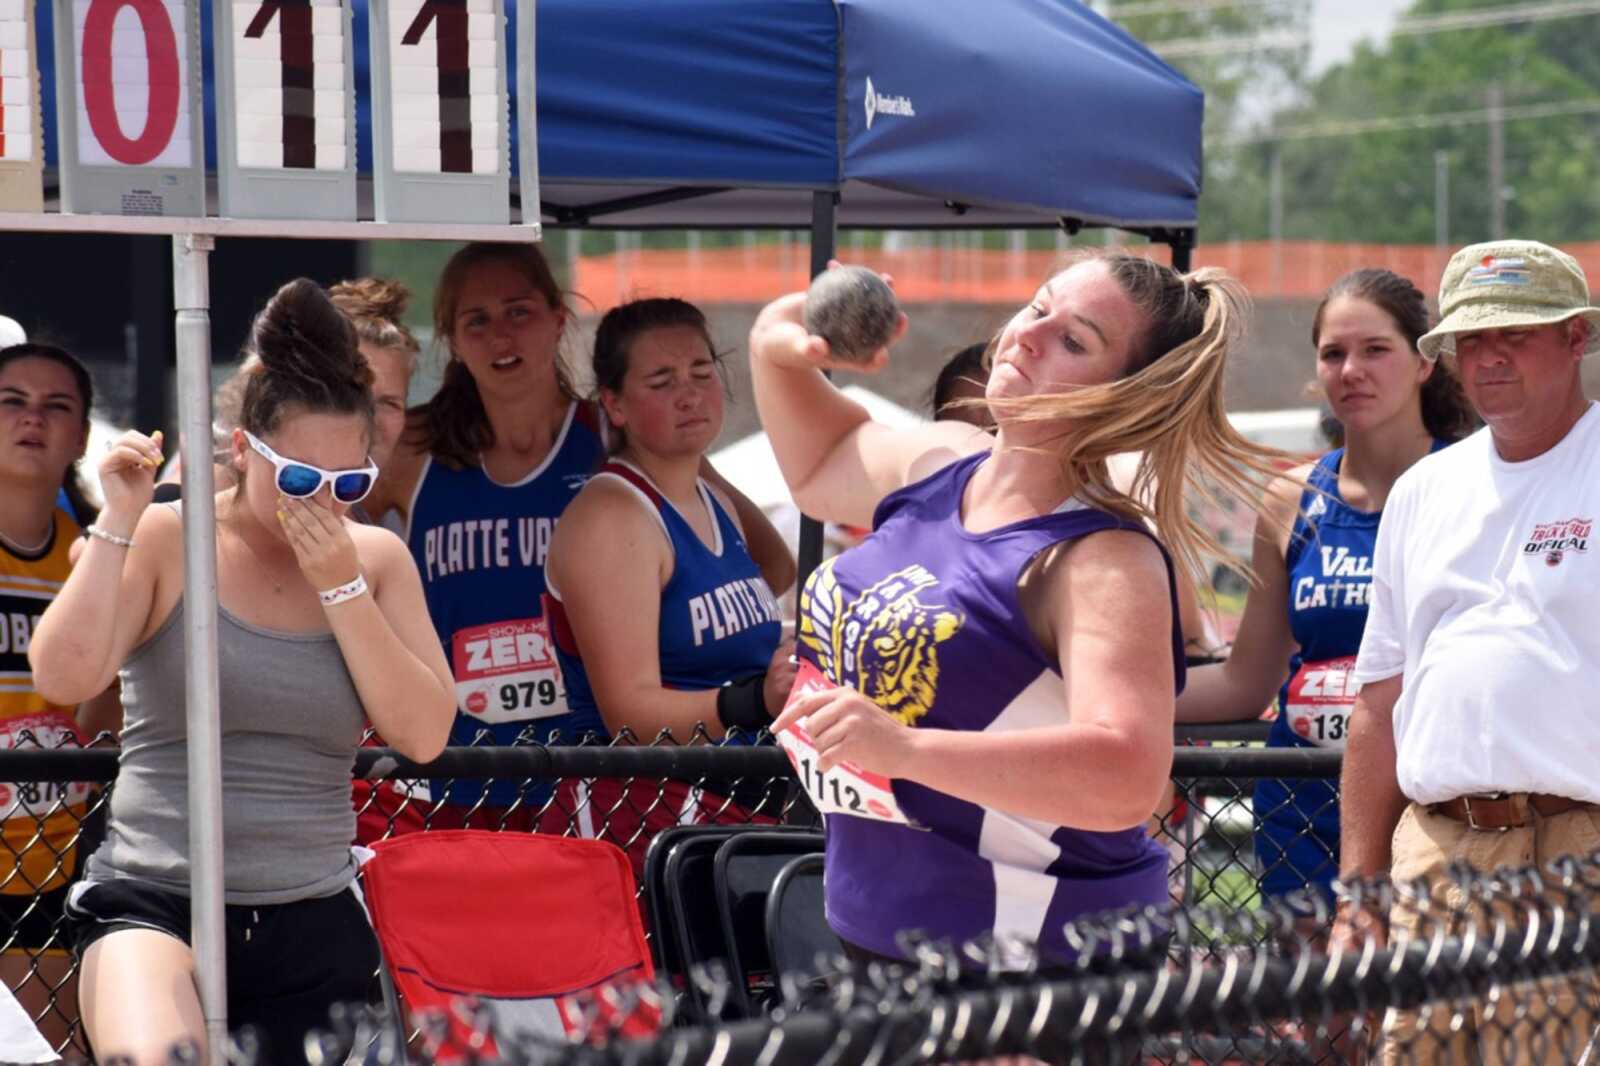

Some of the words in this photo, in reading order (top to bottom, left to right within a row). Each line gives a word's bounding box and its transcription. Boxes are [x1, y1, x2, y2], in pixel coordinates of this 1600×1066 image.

[82, 0, 180, 165] 0
[244, 0, 316, 168] 1
[401, 0, 473, 173] 1
[425, 518, 509, 582] PLATTE
[518, 517, 560, 566] VA
[688, 579, 764, 647] PLATTE
[500, 679, 556, 710] 979
[1314, 714, 1350, 740] 13
[801, 758, 868, 814] 1112
